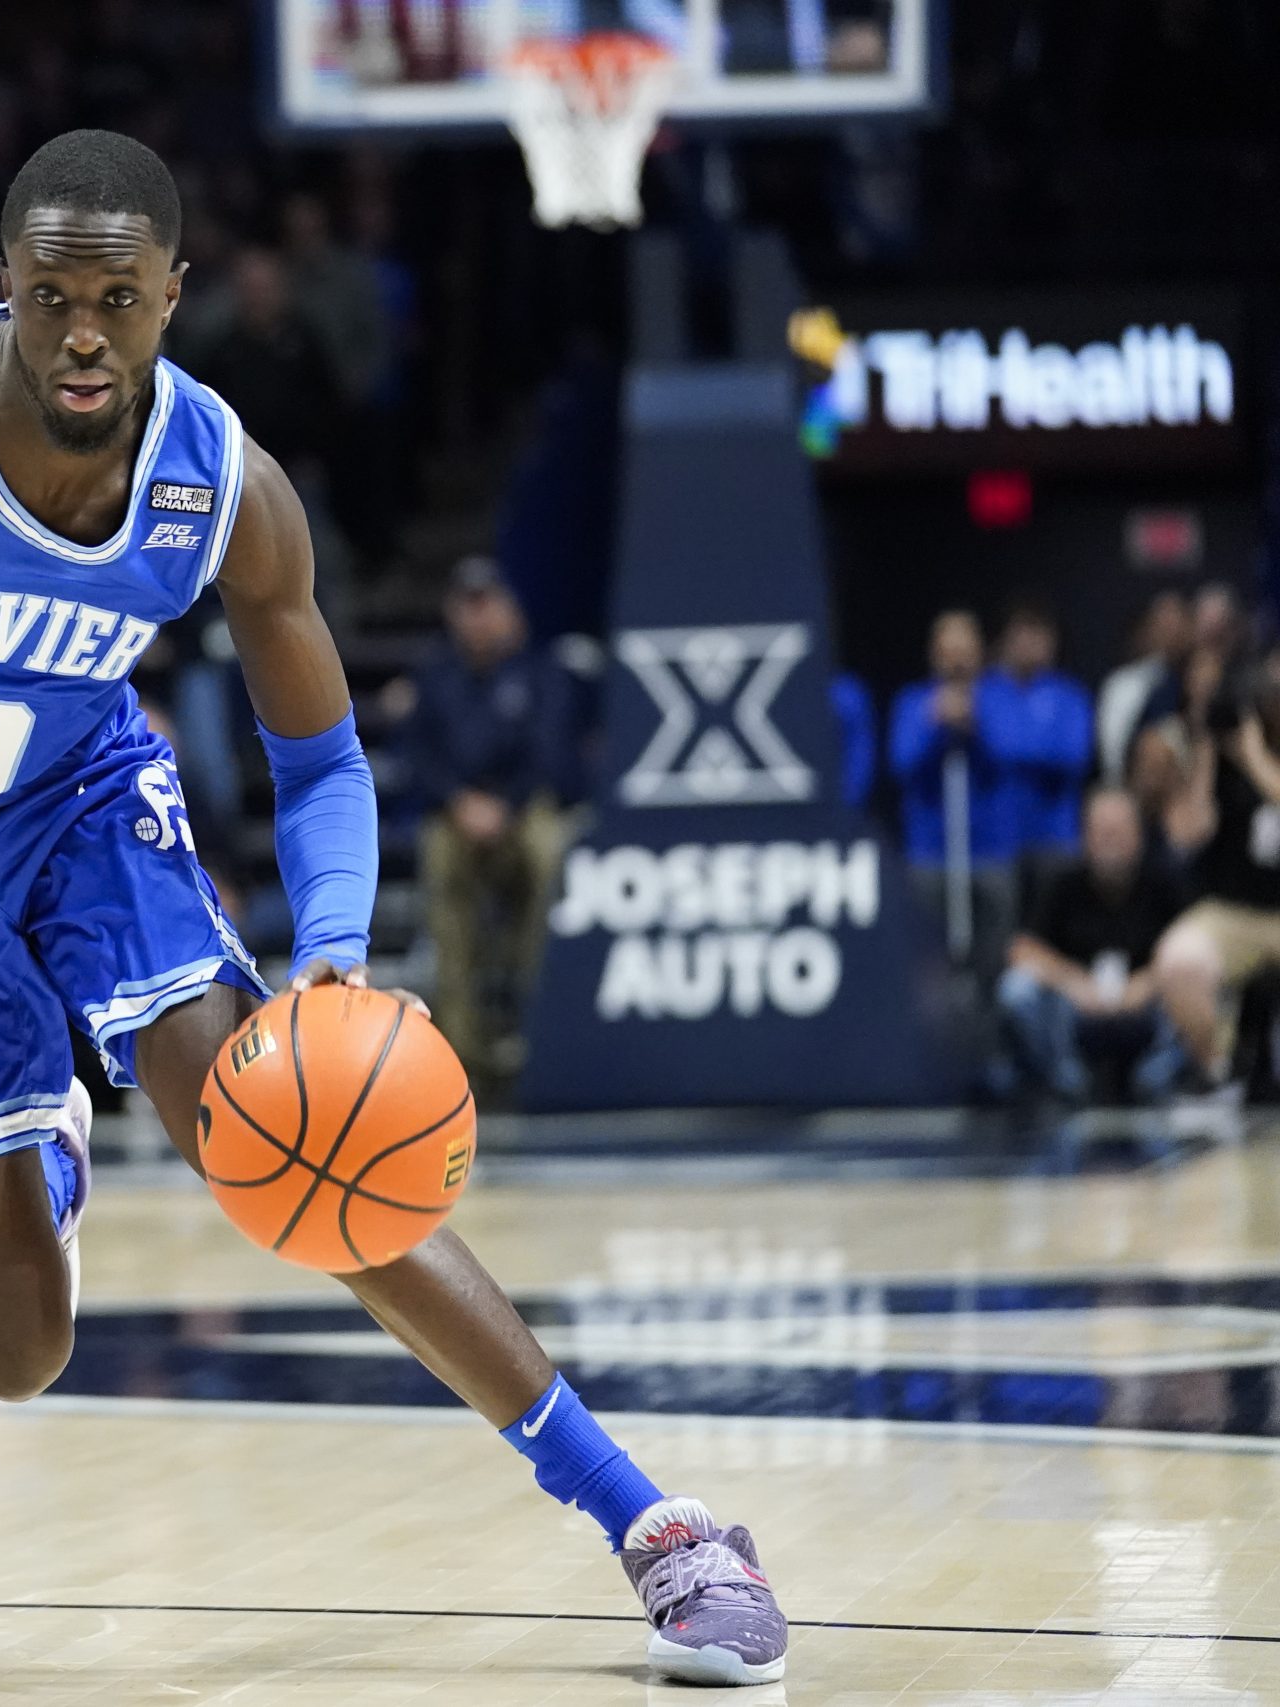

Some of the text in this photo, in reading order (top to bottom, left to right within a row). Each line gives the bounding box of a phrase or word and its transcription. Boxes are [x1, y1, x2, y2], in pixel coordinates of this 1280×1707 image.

[863, 322, 1234, 430] TriHealth
[151, 498, 212, 513] CHANGE
[152, 523, 194, 536] BIG
[145, 534, 202, 547] EAST
[549, 838, 880, 938] JOSEPH
[596, 926, 842, 1021] AUTO
